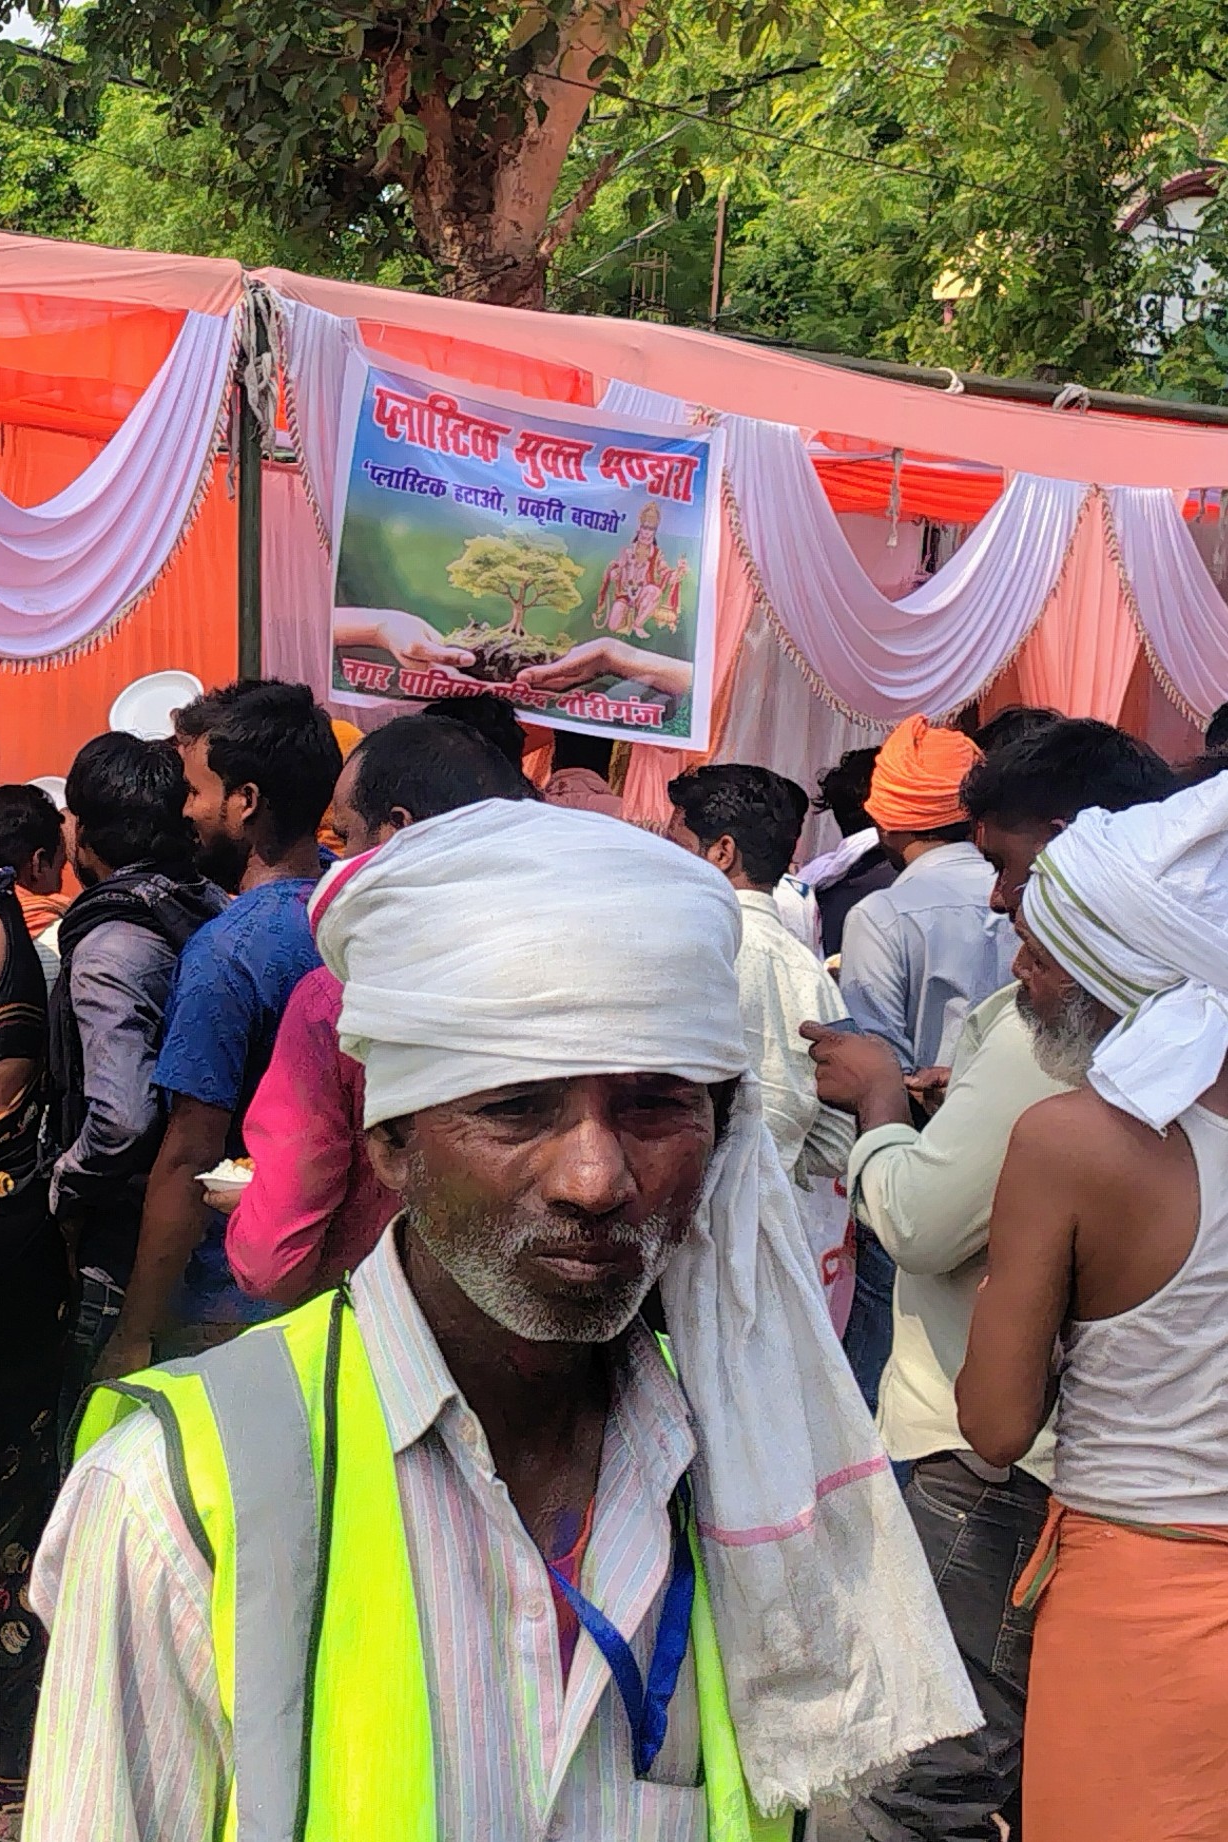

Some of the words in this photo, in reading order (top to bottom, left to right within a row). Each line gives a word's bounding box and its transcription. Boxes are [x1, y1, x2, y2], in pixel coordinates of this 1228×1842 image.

[374, 388, 512, 463] प्लास्टिक
[514, 431, 594, 489] मुक्त
[600, 447, 698, 502] भण्डारा
[453, 484, 509, 516] हटाओ,
[518, 497, 567, 526] प्रकृति
[342, 659, 394, 691] नगर
